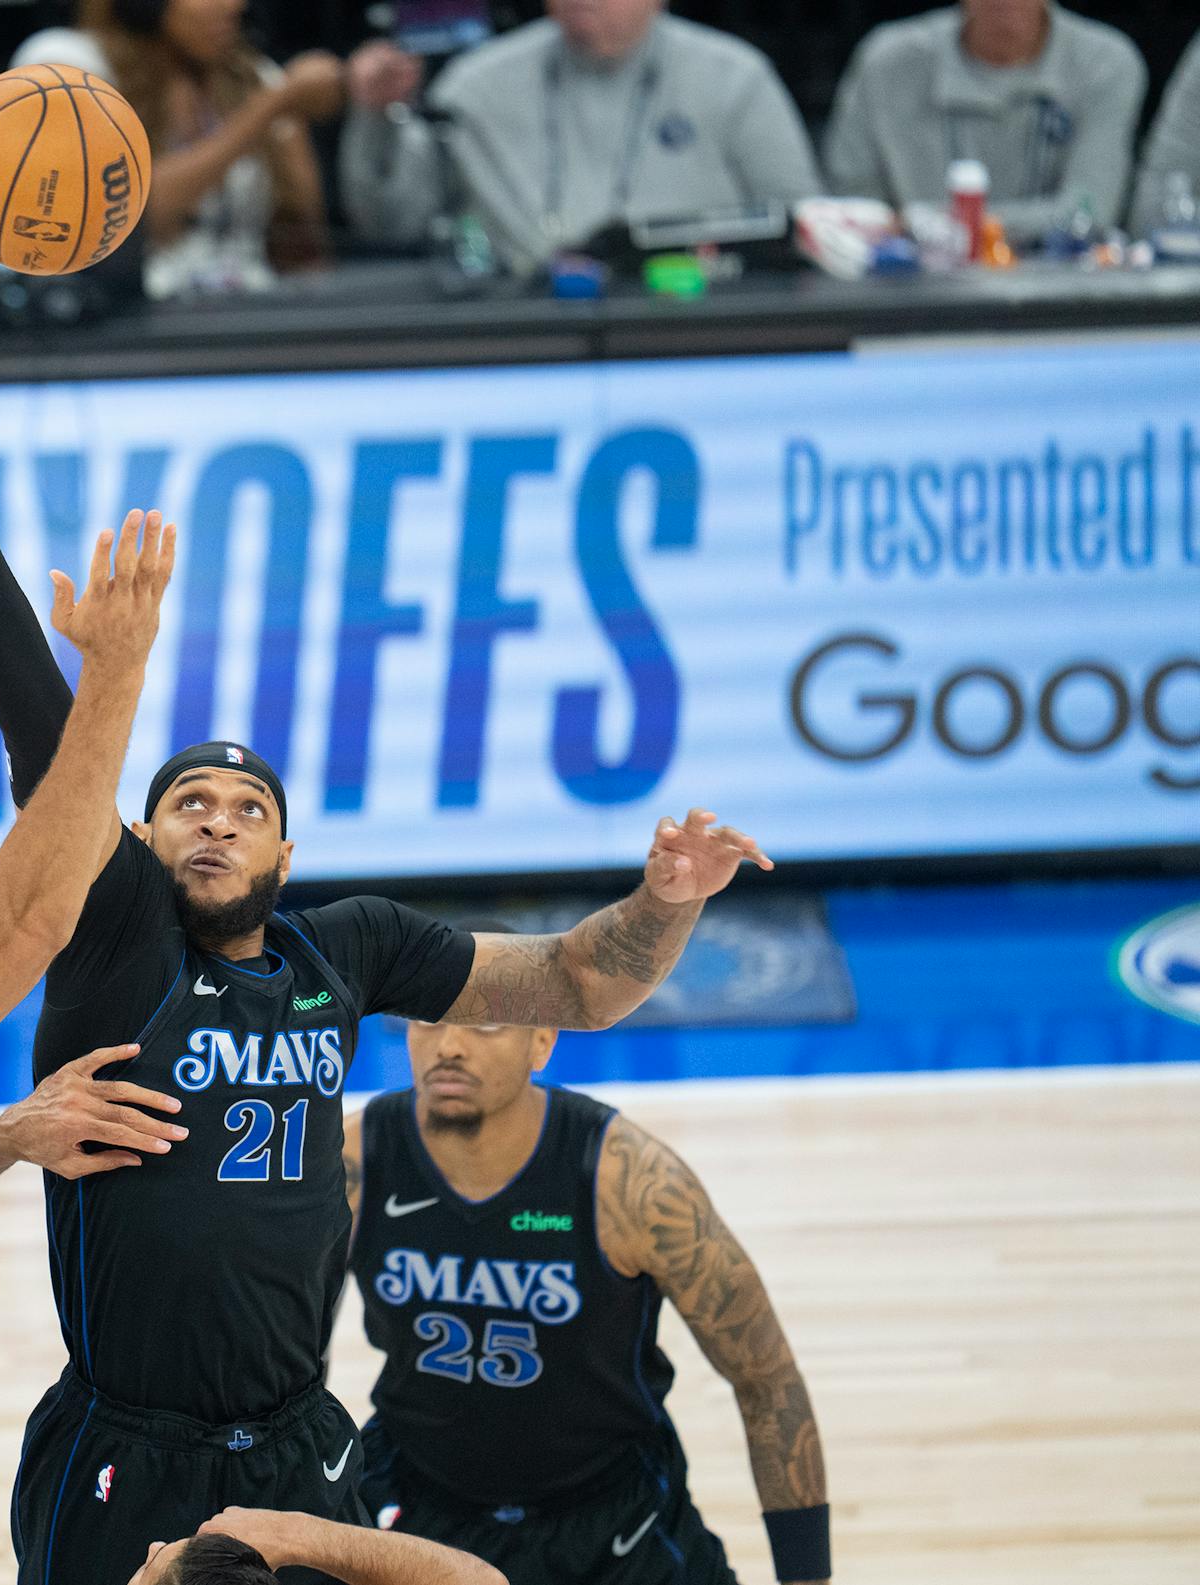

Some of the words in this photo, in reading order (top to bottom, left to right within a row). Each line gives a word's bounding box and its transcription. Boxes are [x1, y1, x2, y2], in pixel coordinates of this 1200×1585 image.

[785, 424, 1156, 577] Presented
[172, 1027, 344, 1099] MAVS
[217, 1099, 309, 1182] 21
[510, 1210, 574, 1232] chime
[374, 1248, 583, 1325] MAVS
[413, 1311, 544, 1388] 25
